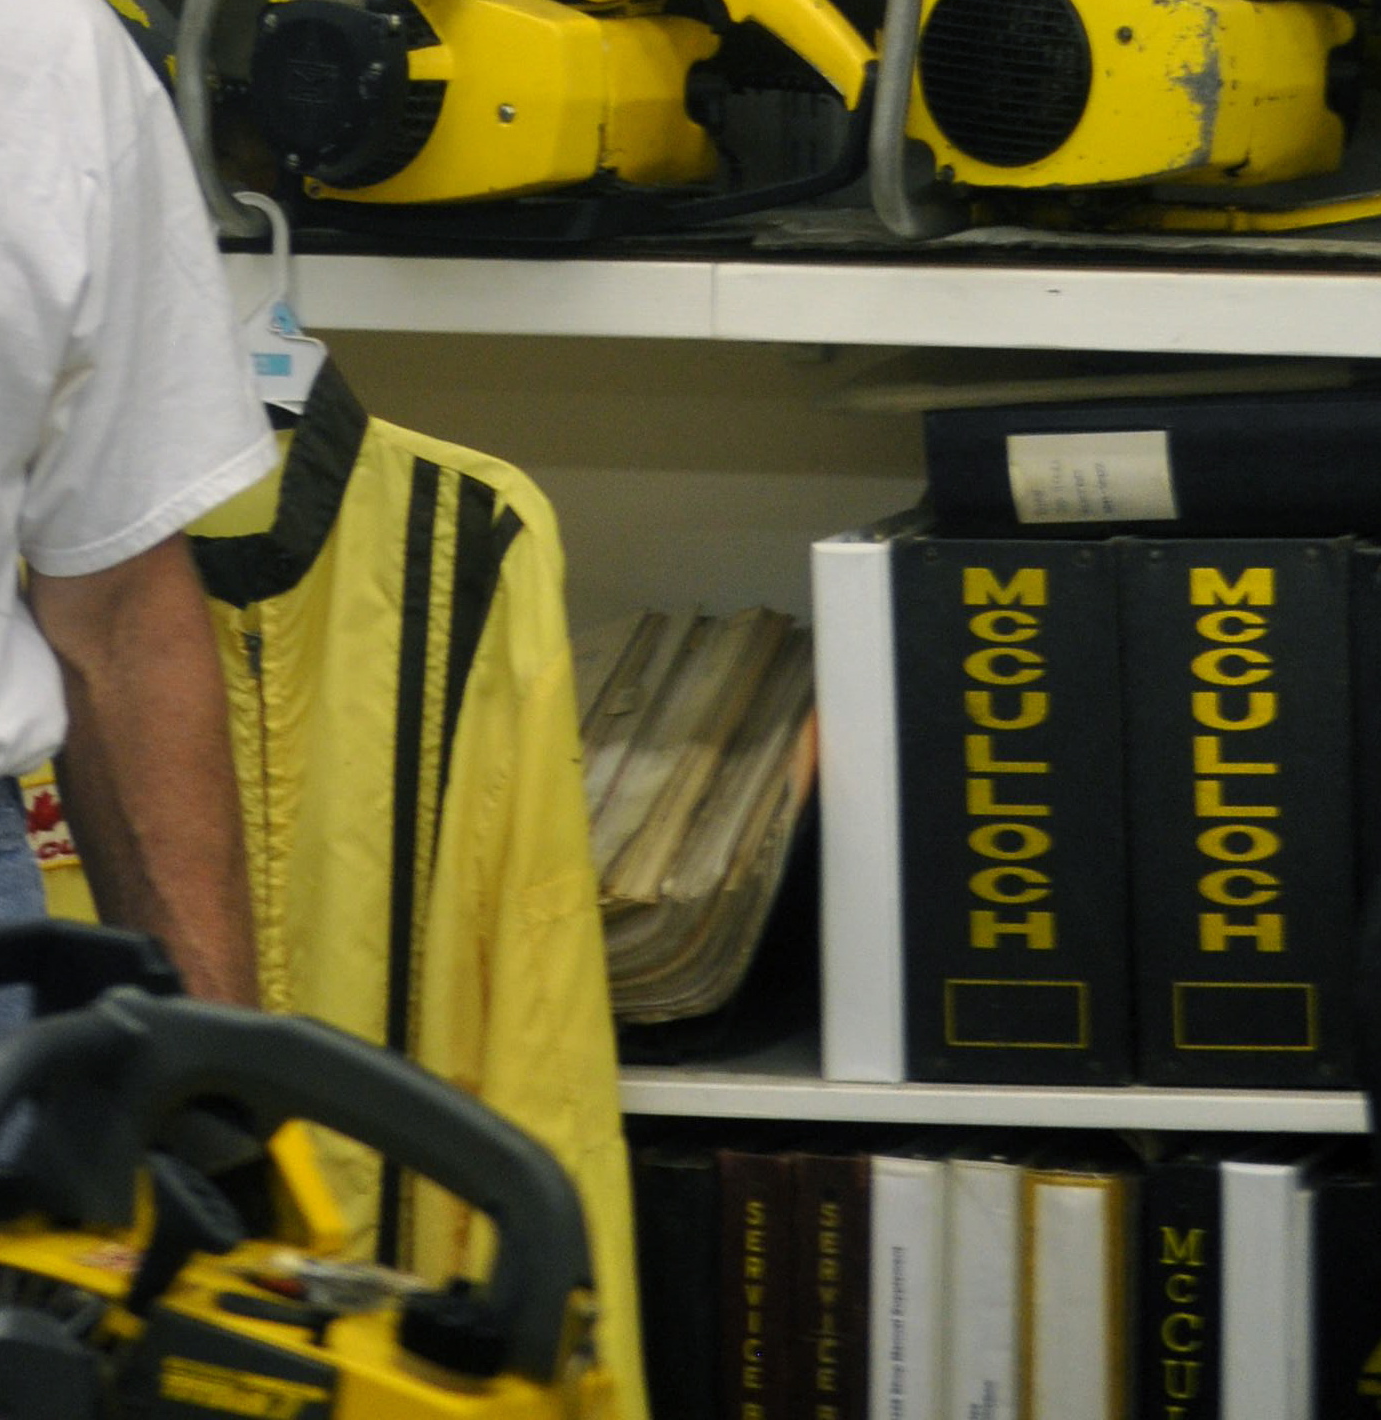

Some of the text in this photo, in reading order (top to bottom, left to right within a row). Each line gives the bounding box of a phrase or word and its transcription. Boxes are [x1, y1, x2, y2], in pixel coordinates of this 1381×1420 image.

[742, 1199, 767, 1390] SERVICE
[814, 1201, 842, 1392] SERVICE
[1158, 1226, 1208, 1420] McCU
